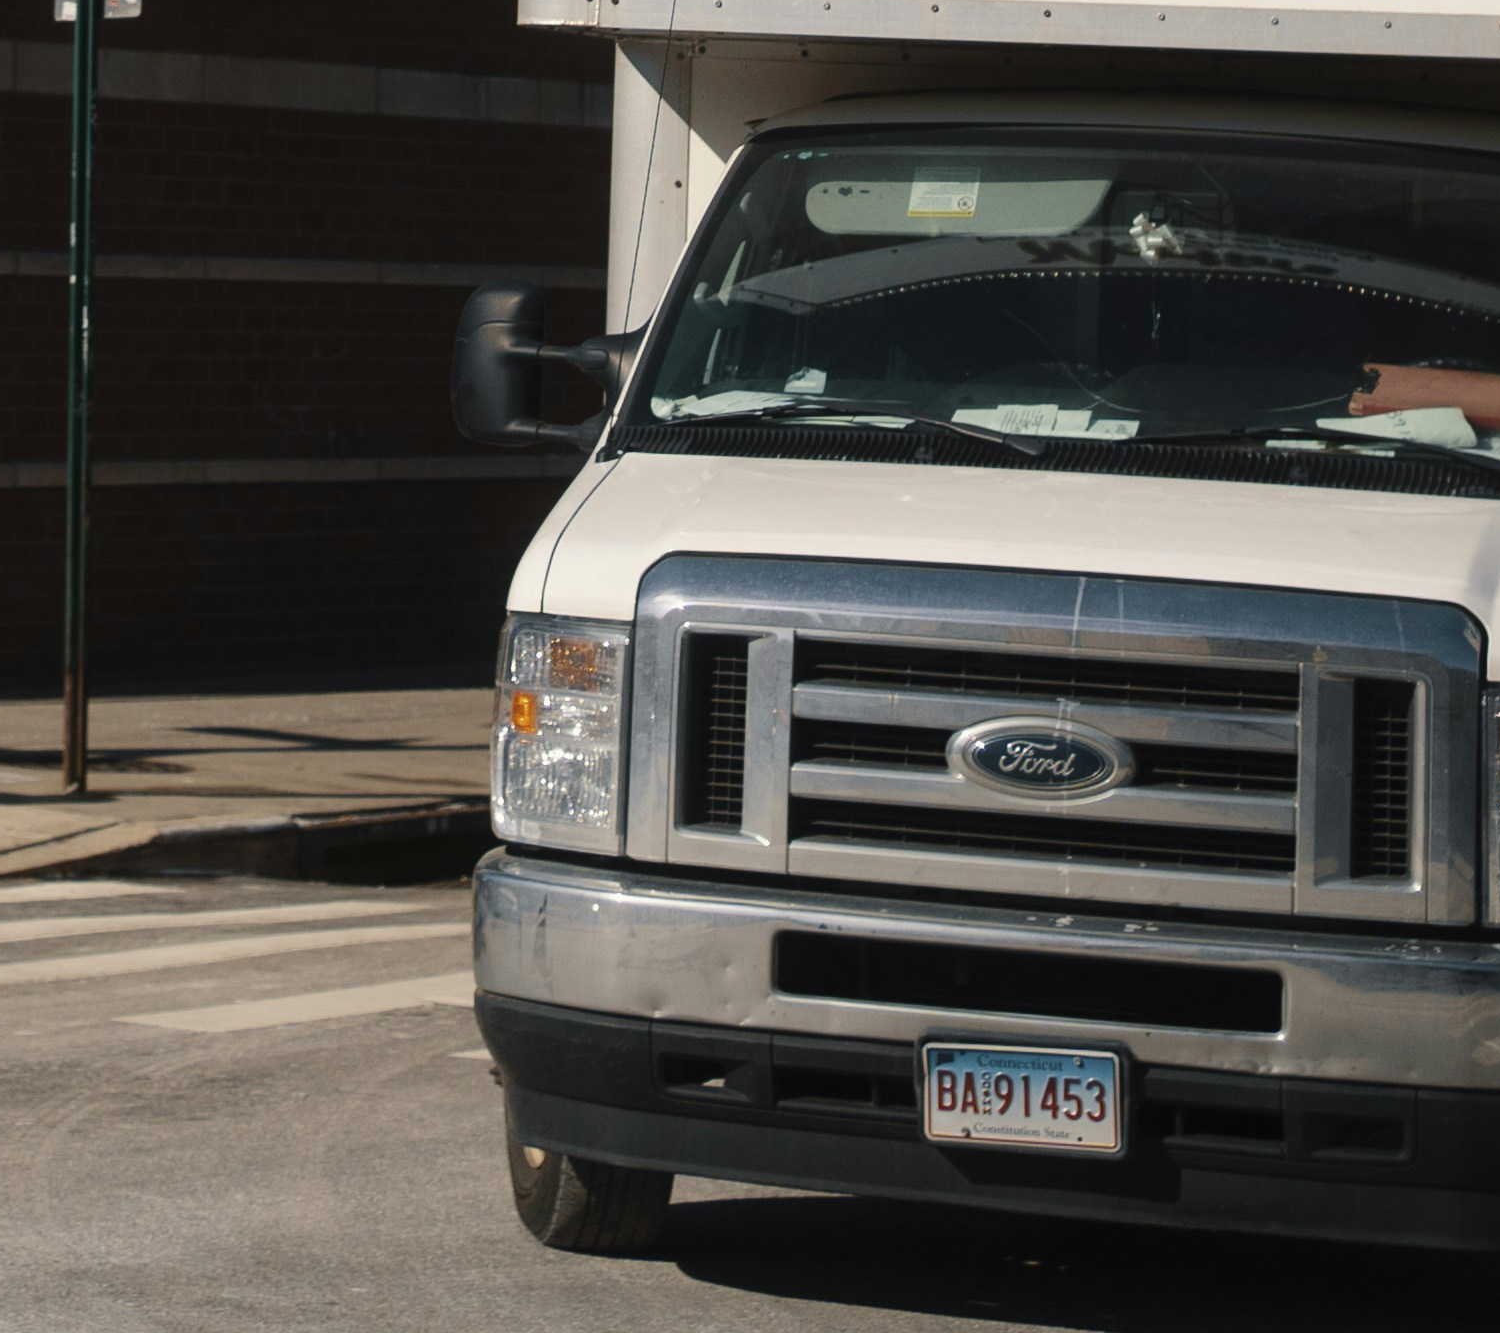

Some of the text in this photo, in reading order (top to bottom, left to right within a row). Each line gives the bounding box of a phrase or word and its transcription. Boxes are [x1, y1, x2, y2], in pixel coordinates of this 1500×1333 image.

[998, 739, 1077, 777] Ford
[976, 1054, 1063, 1072] Connecticut
[972, 1122, 1070, 1140] Constitution State
